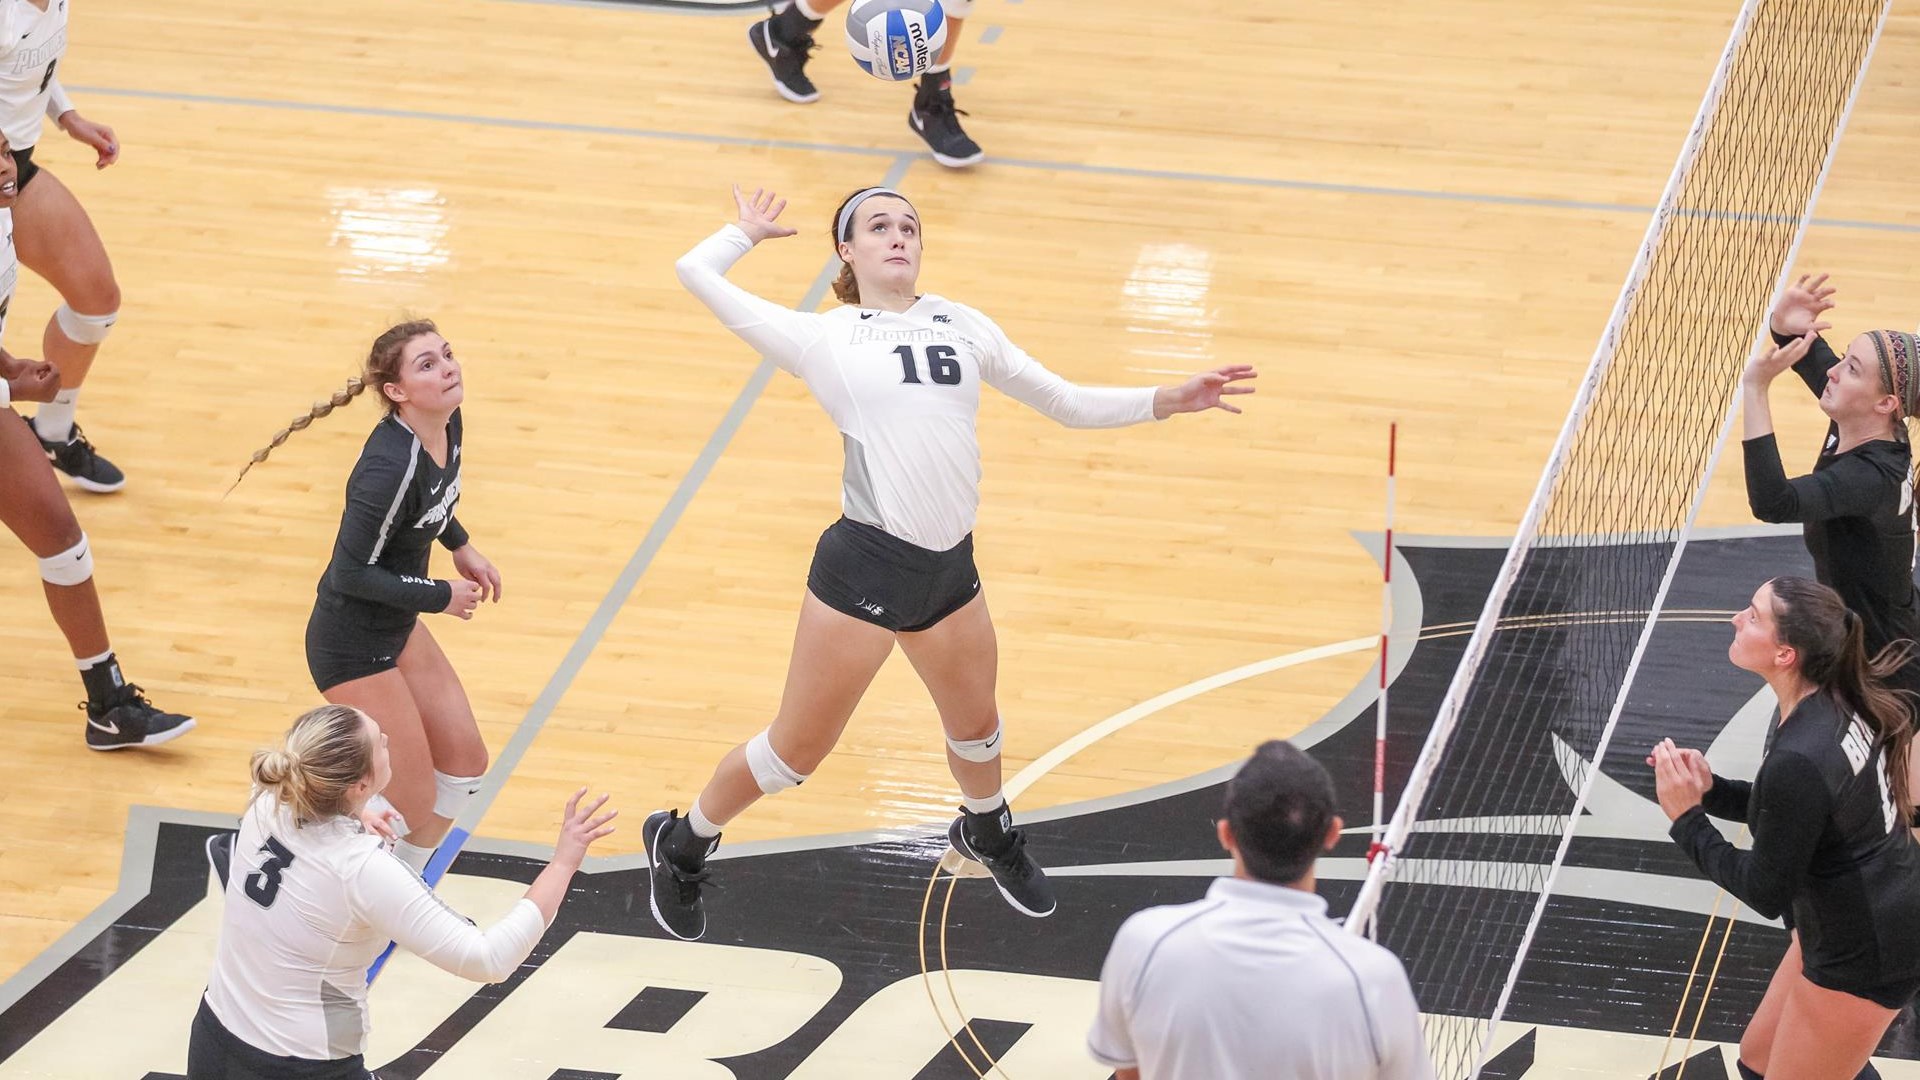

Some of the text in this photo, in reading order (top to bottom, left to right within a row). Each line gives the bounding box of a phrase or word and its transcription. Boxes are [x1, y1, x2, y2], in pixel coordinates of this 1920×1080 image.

[891, 35, 911, 73] NCAA
[909, 22, 928, 72] molten
[850, 324, 974, 348] PROVIDEN
[891, 345, 962, 386] 16
[243, 834, 296, 909] 3
